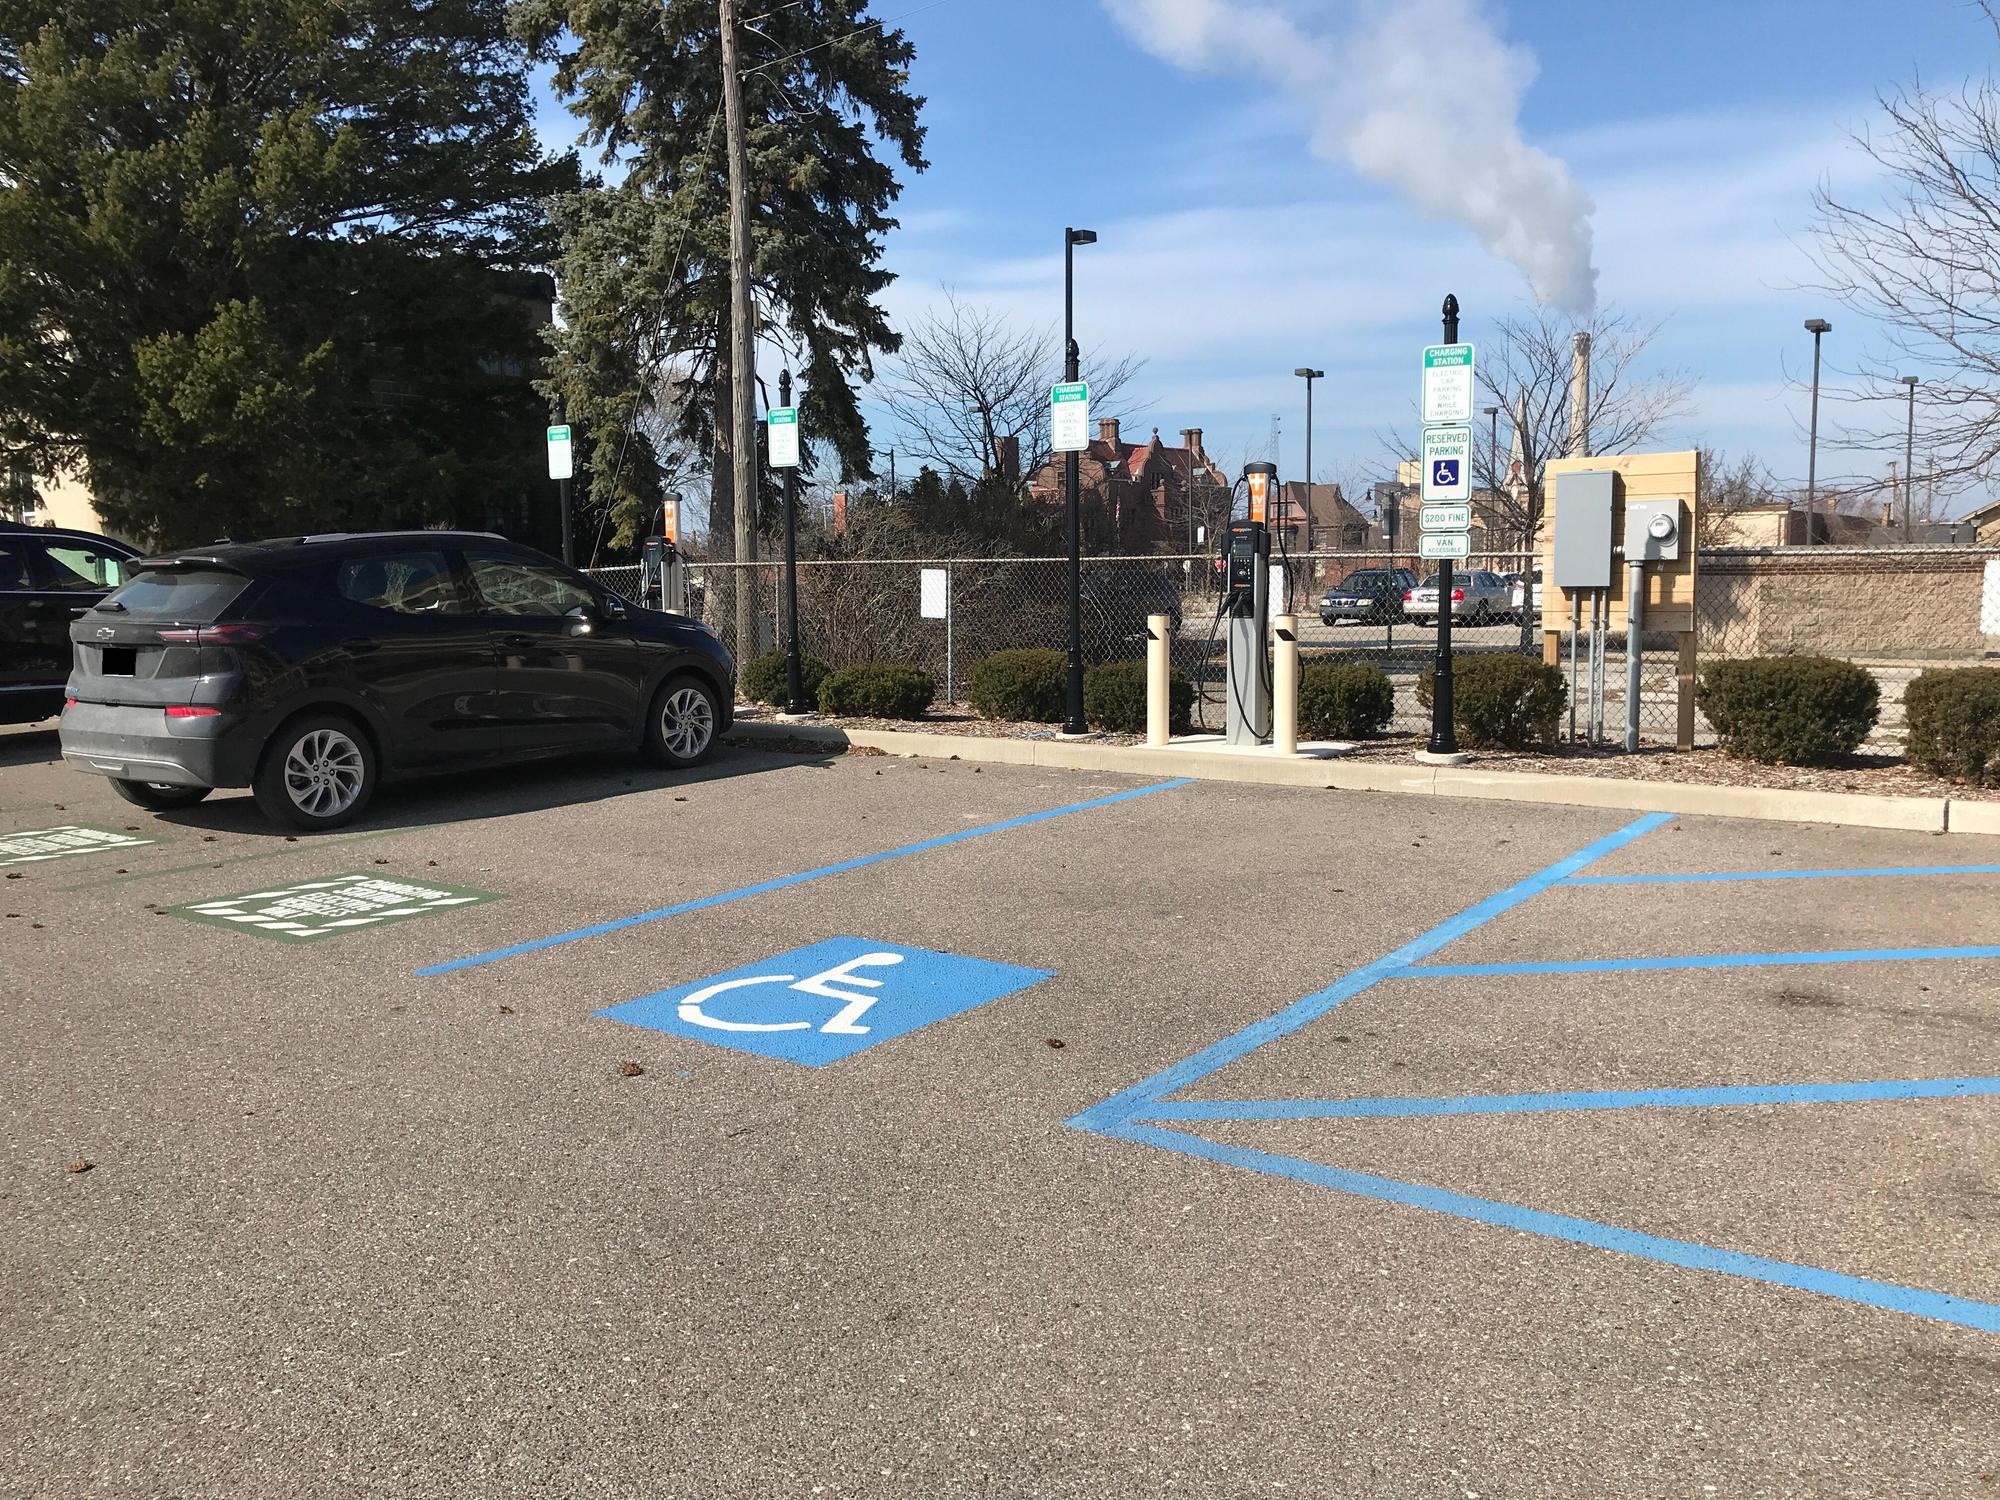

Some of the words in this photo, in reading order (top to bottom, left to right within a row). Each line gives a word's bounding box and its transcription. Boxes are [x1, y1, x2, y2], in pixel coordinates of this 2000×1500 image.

[1429, 347, 1468, 357] CHARGING
[1433, 356, 1464, 366] STATION
[1432, 369, 1463, 377] ELECTRIC
[1430, 409, 1465, 417] CHARGING
[1426, 434, 1468, 444] RESERVED
[1429, 446, 1464, 456] PARKING
[1425, 514, 1445, 523] $200
[1448, 513, 1466, 522] FINE
[1428, 546, 1462, 554] ACCESSIBLE
